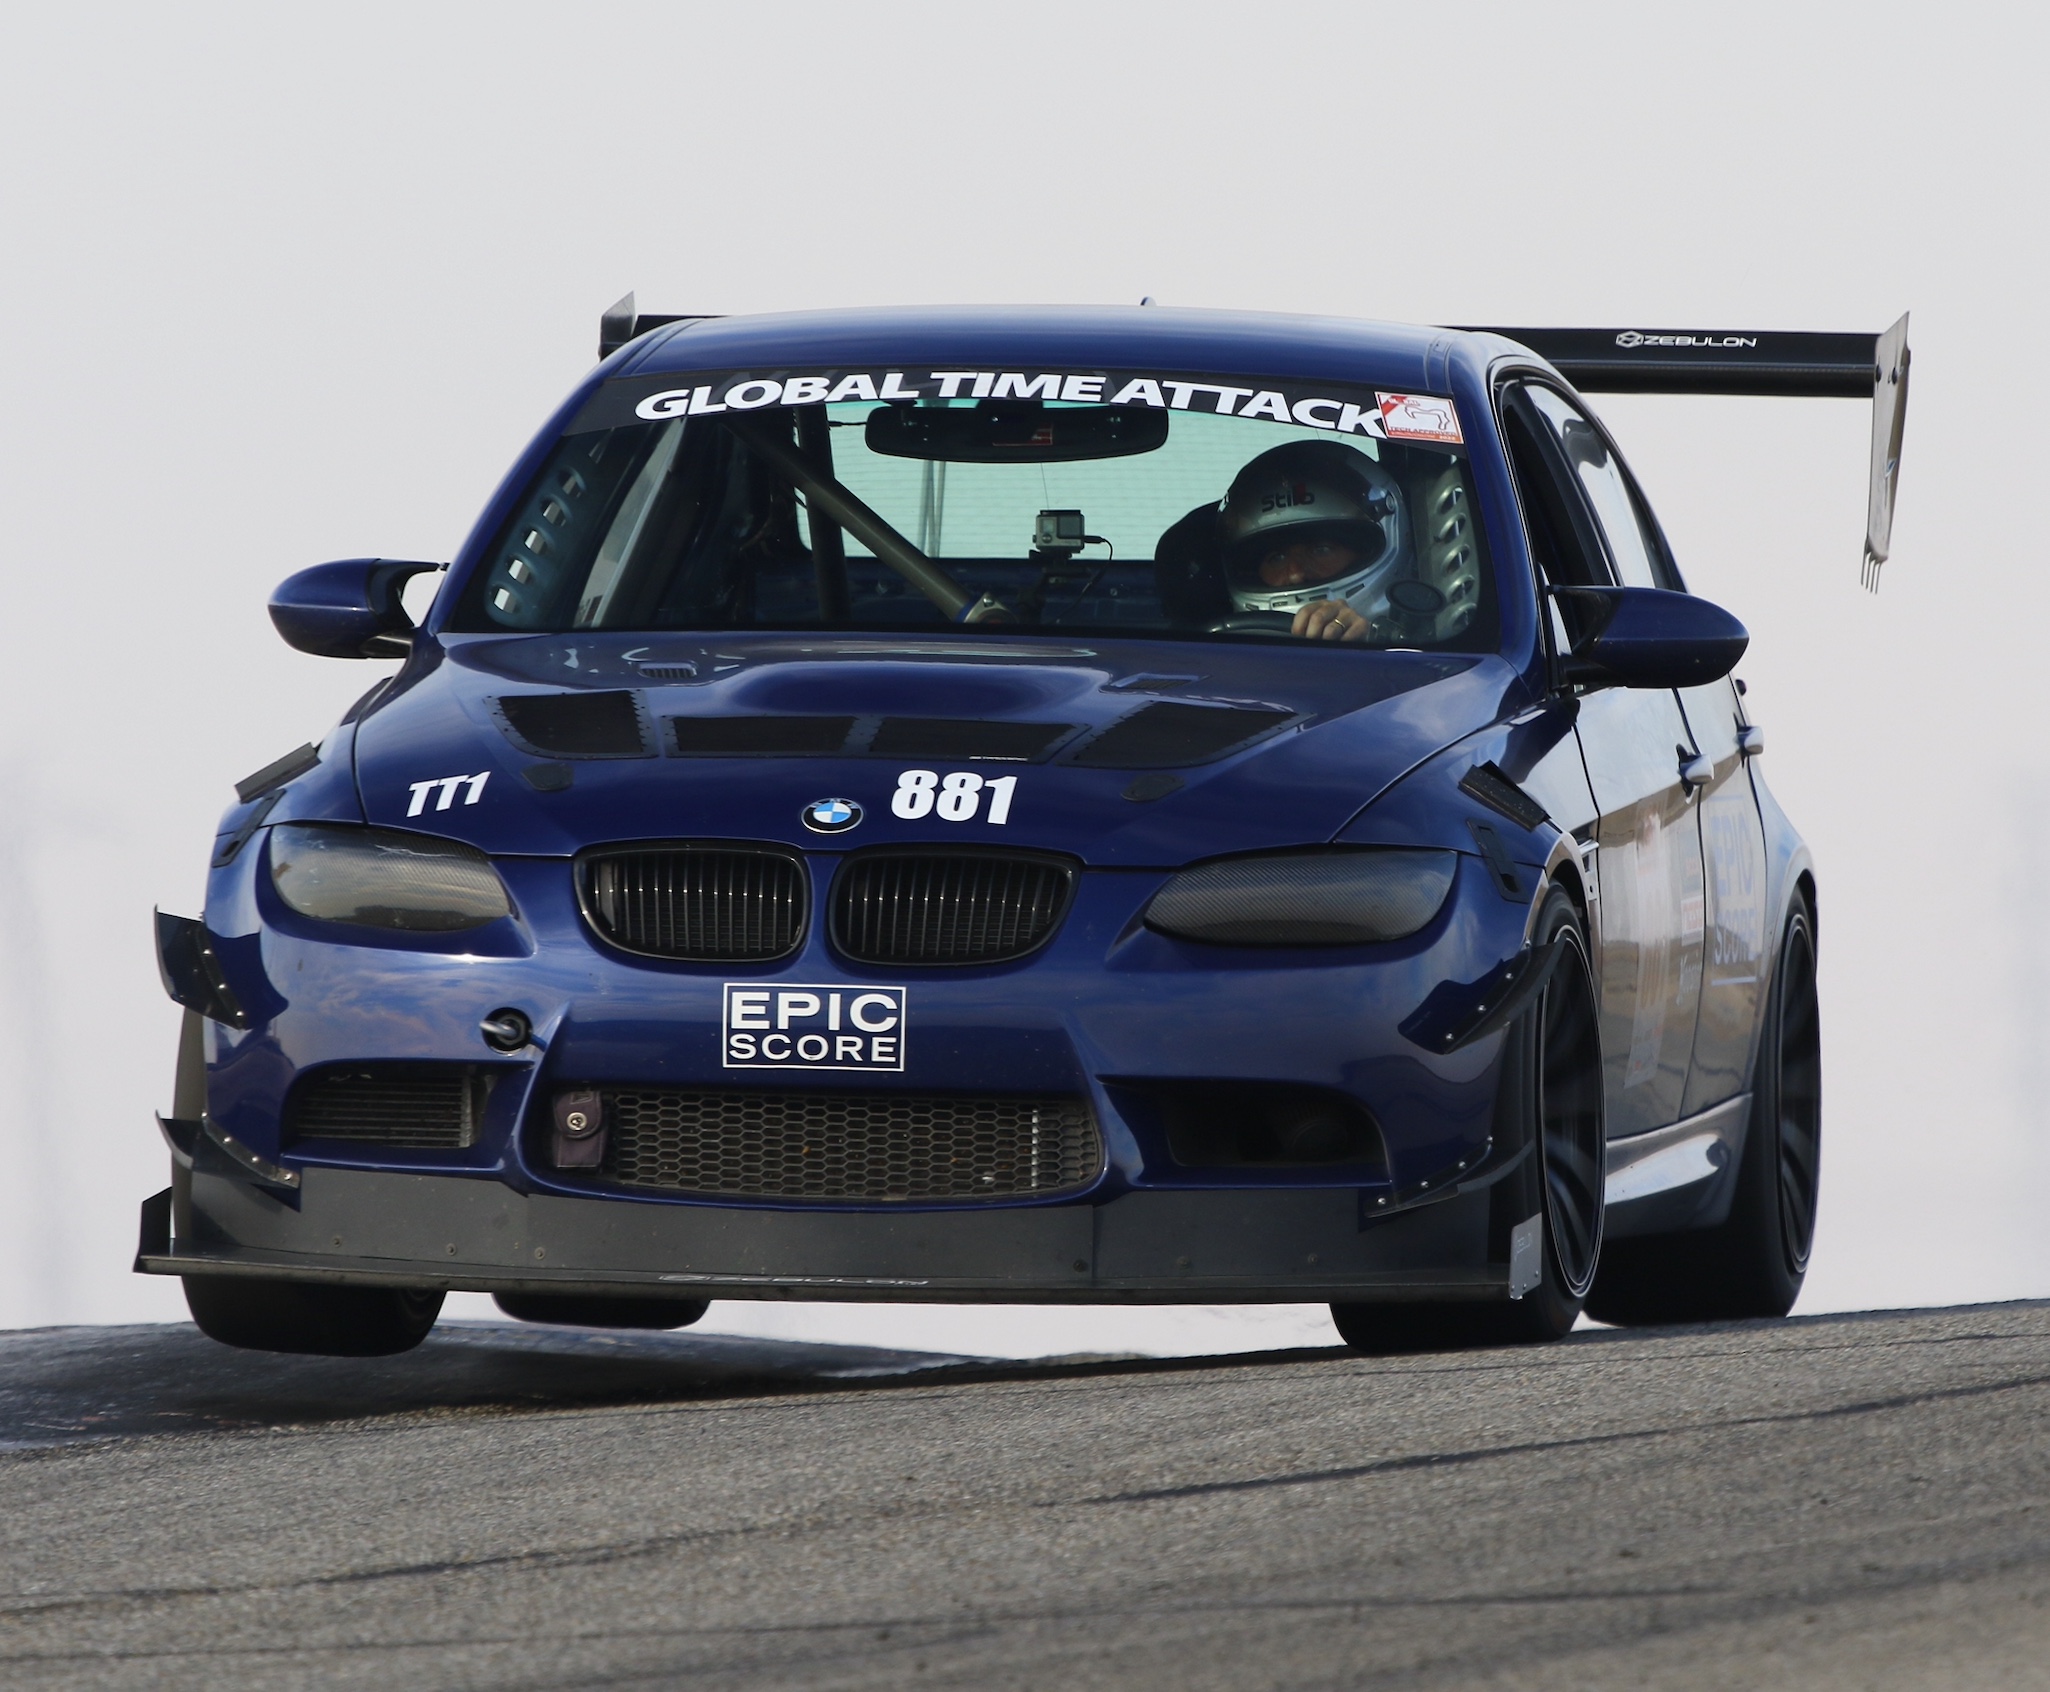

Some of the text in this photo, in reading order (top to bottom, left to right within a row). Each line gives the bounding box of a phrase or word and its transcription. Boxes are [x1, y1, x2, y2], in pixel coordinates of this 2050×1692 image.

[1643, 335, 1758, 348] ZEBULON
[635, 373, 1387, 440] GLOBAL TIME ATTACK
[406, 771, 491, 818] TT1
[891, 769, 1018, 825] 881
[1710, 811, 1755, 898] EPIC
[1714, 907, 1758, 966] SCORE
[730, 991, 898, 1033] EPIC
[729, 1033, 897, 1062] SCORE
